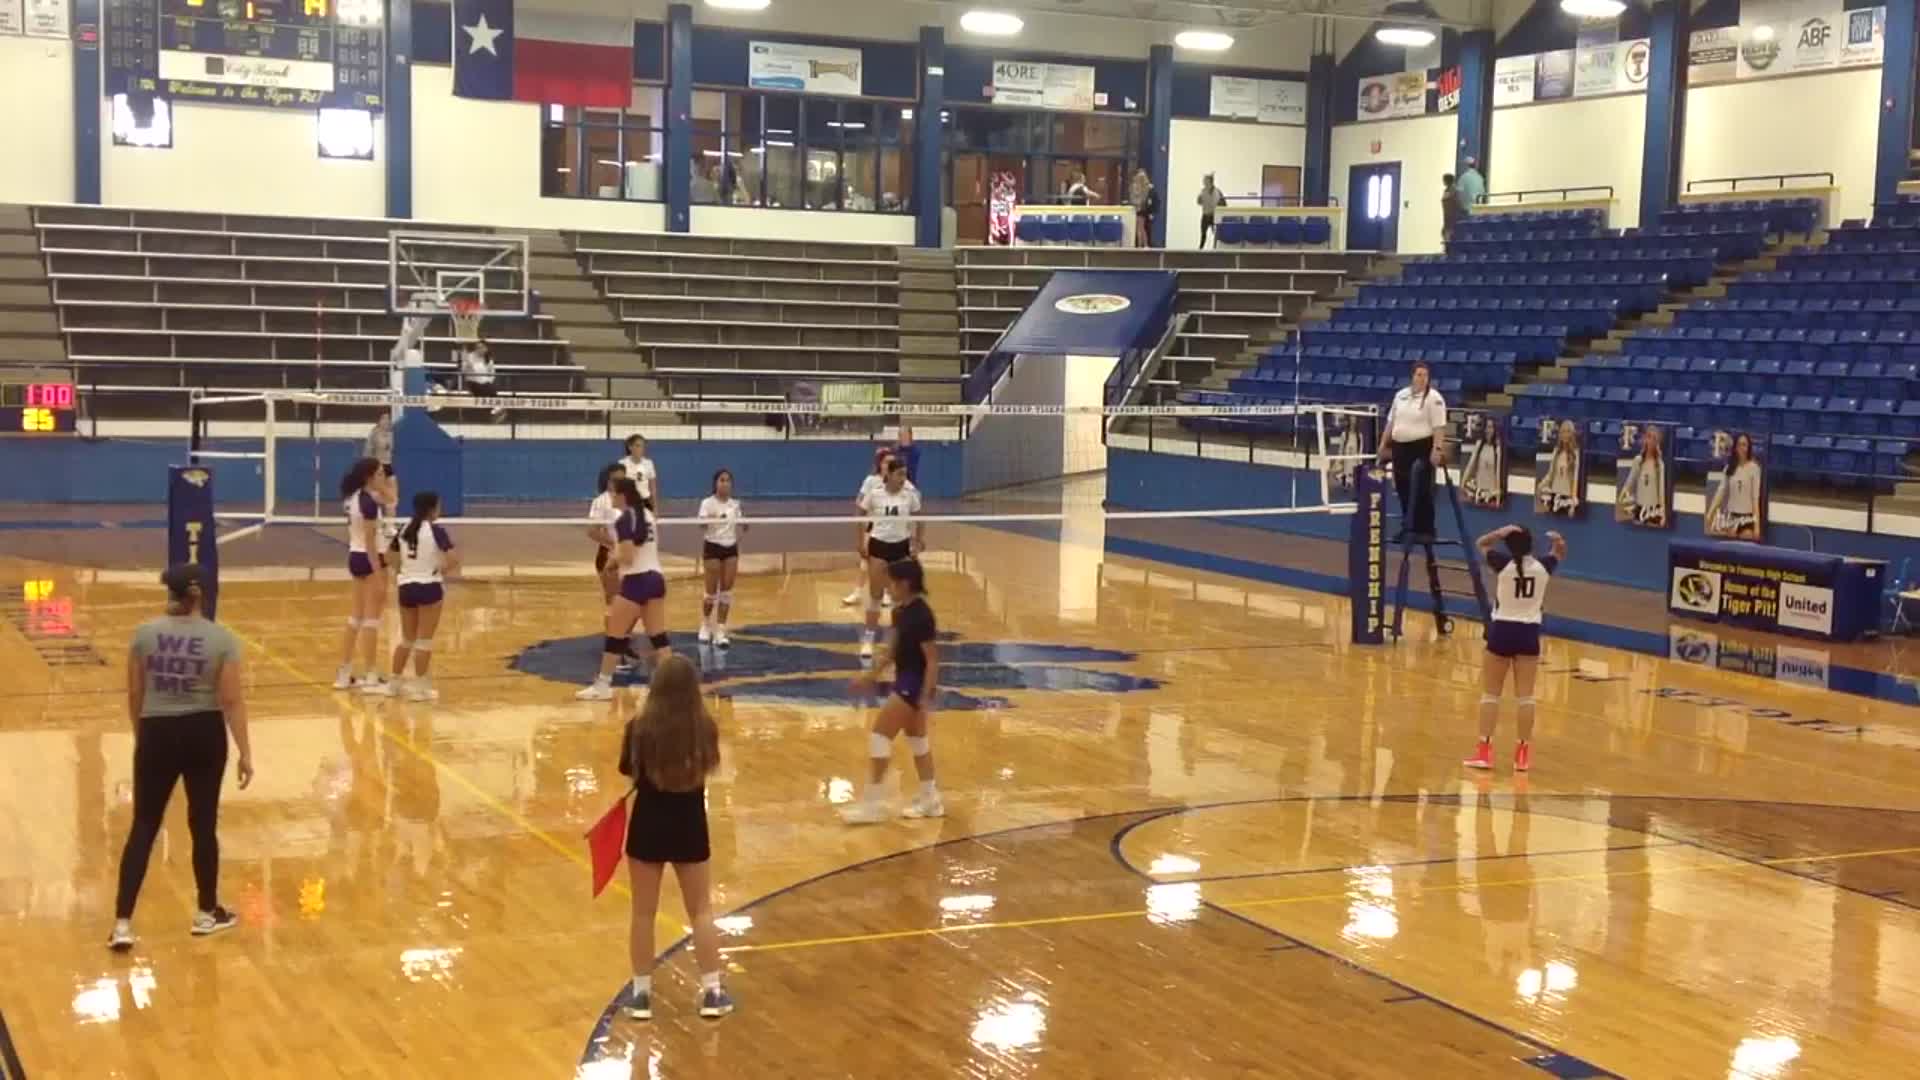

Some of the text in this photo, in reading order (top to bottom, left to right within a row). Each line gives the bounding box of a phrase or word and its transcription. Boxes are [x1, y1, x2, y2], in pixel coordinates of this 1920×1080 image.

[1797, 26, 1831, 48] ABF
[23, 408, 55, 430] 25
[1368, 493, 1382, 633] FRENSHIP
[1513, 576, 1535, 599] 10
[1722, 594, 1751, 616] Tiger
[1785, 595, 1827, 615] United
[157, 633, 205, 655] WE
[146, 656, 208, 676] NOT
[155, 677, 199, 692] ME
